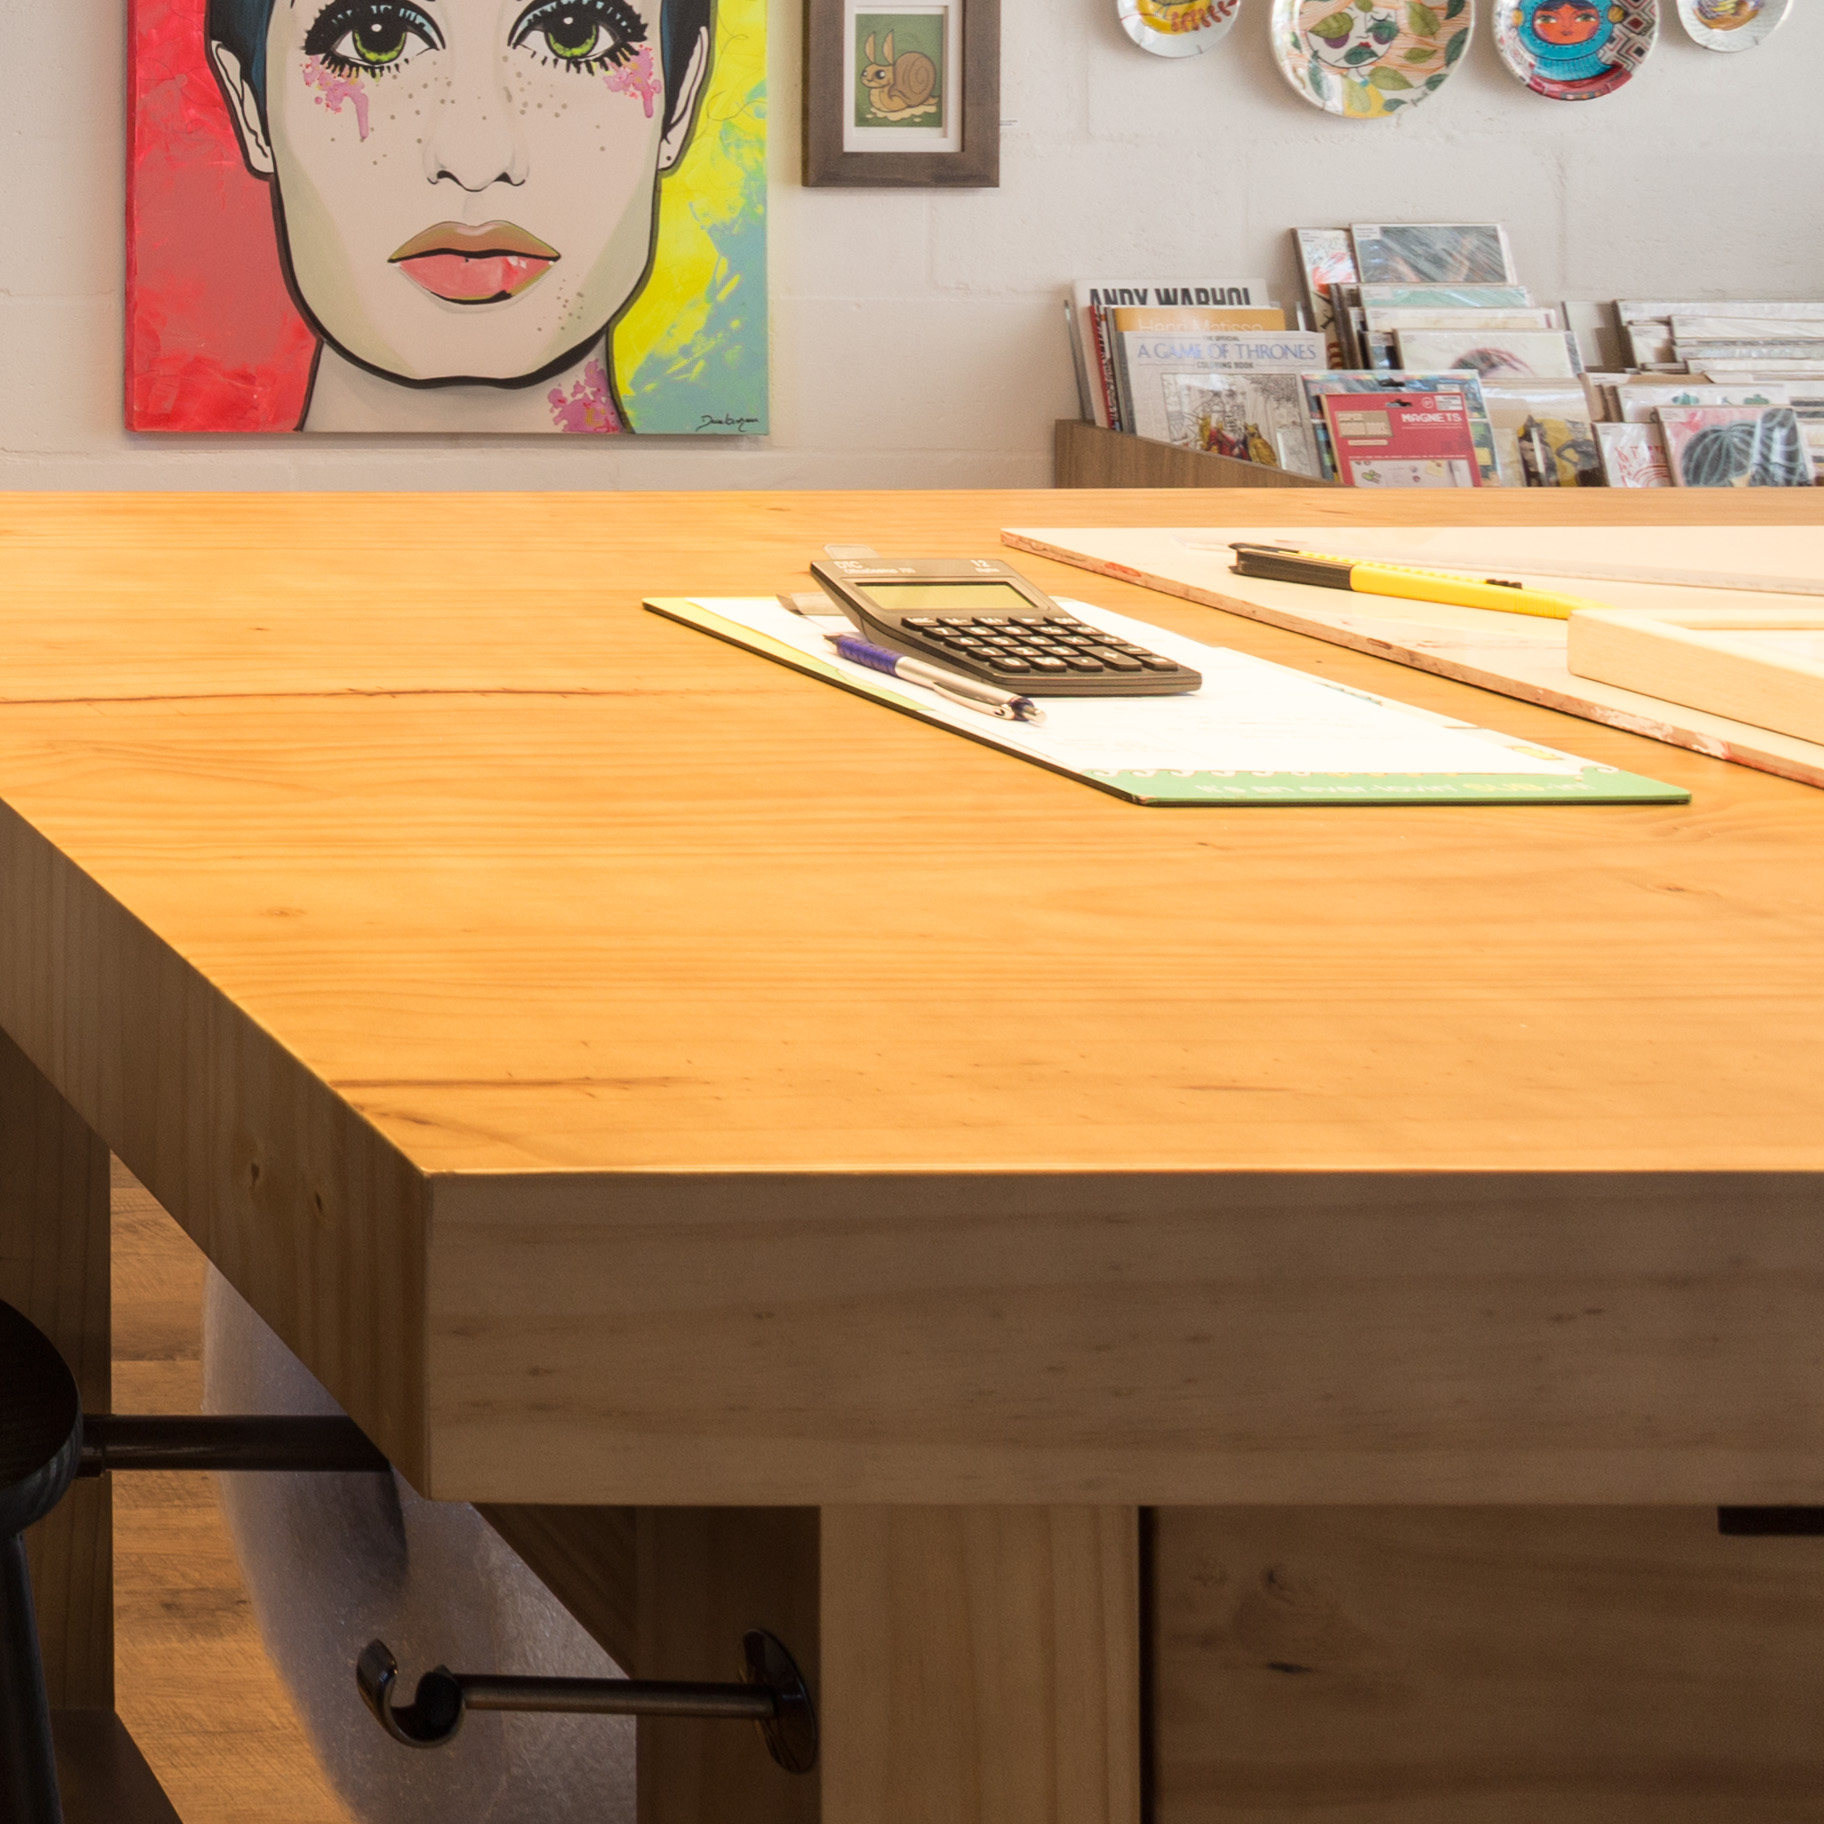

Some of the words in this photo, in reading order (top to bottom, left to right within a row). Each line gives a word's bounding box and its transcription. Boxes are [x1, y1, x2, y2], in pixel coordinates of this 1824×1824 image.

[1191, 319, 1264, 332] Matisse
[1137, 343, 1152, 359] A
[1154, 342, 1202, 360] GAME
[1207, 343, 1230, 360] OF
[1233, 343, 1317, 361] THRONES
[1400, 412, 1463, 423] MAGNETS
